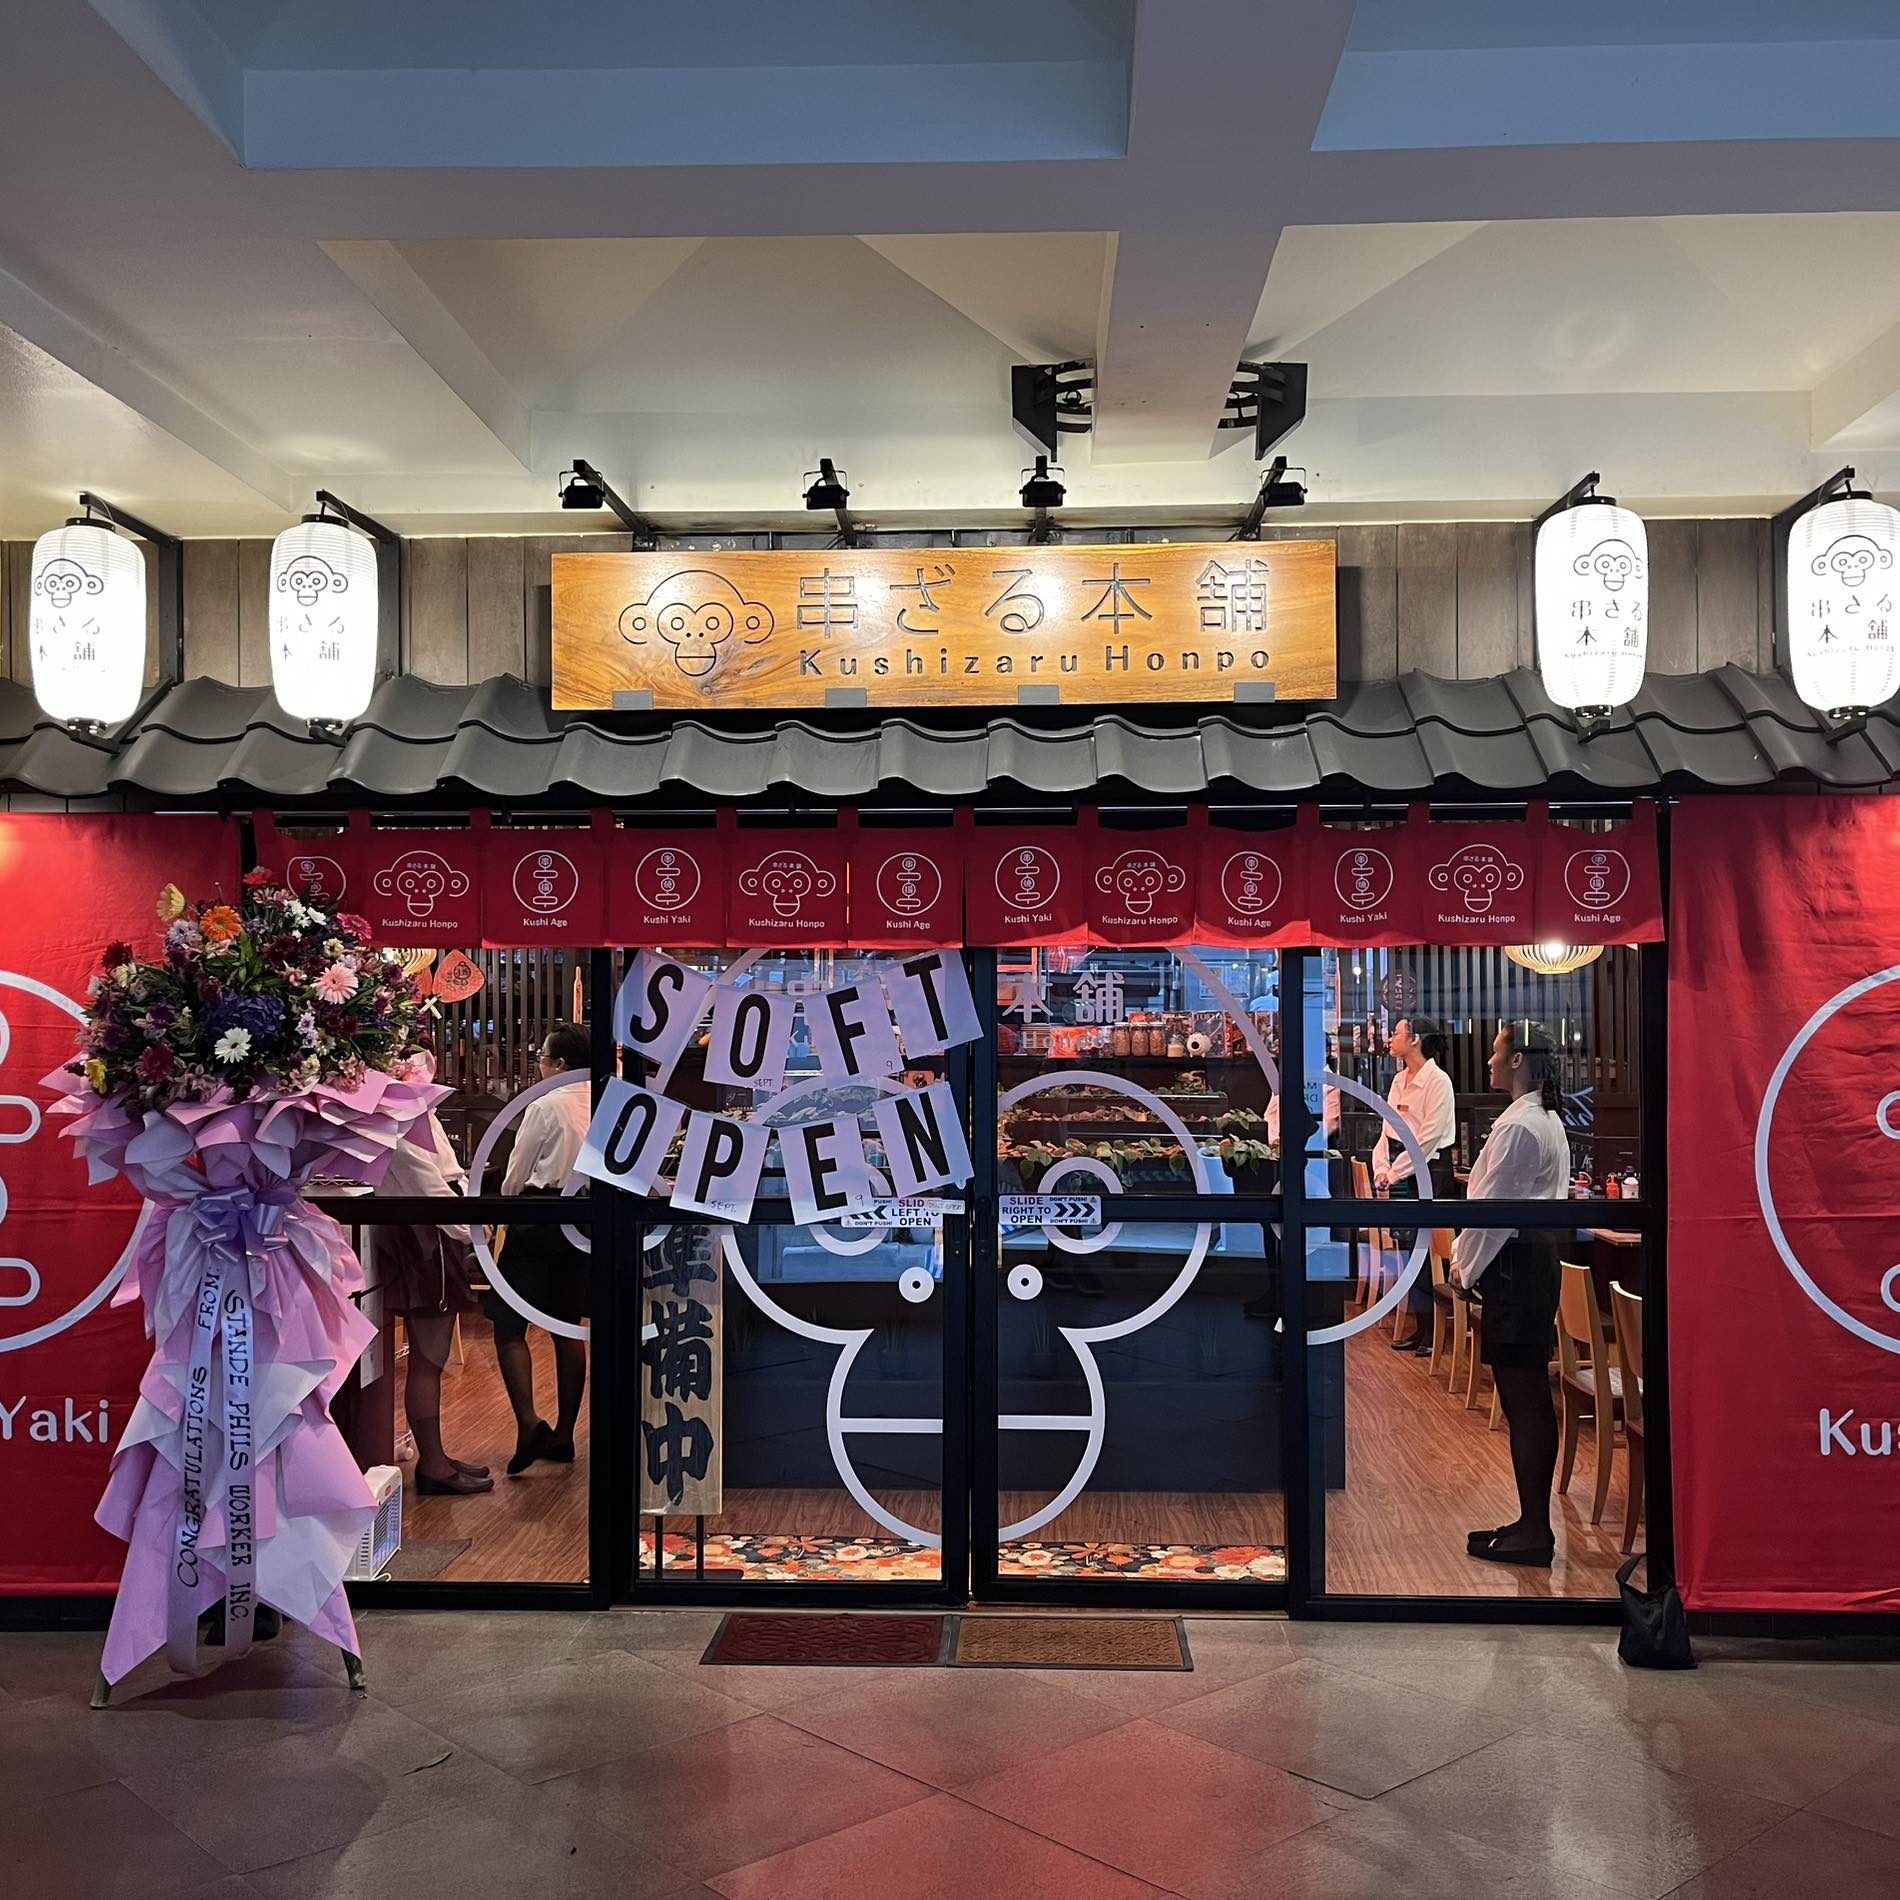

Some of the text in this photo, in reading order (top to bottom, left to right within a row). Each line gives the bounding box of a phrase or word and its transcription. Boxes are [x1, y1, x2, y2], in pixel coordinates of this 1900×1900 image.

[797, 559, 1269, 639] 串ざる本舗
[799, 645, 1269, 676] Kushizaru Honpo
[523, 918, 568, 928] Kushi Age
[643, 915, 691, 924] Kushi Yaki
[1004, 913, 1052, 924] Kushi Yaki
[1102, 915, 1178, 926] Kushizaru Honpo
[1227, 916, 1272, 928] Kushi Age
[1340, 912, 1388, 923] Kushi Yaki
[1438, 914, 1516, 924] Kushizaru Honpo
[1574, 914, 1621, 923] Kushi Age
[382, 918, 458, 929] Kushizaru Honpo
[749, 918, 825, 929] Kushizaru Honpo
[886, 920, 930, 930] Kushi Age
[1002, 972, 1125, 1023] 本舗
[630, 954, 948, 1077] SOFT
[604, 1092, 951, 1212] OPEN
[898, 1199, 925, 1208] SLID
[1010, 1197, 1044, 1205] SLIDE
[891, 1208, 919, 1217] LEFT
[899, 1217, 931, 1226] OPEN
[1011, 1215, 1043, 1224] OPEN
[0, 1396, 109, 1443] Yaki
[1819, 1408, 1900, 1456] Ku
[224, 1289, 252, 1622] STANDE PHILS WORKER INC.
[177, 1366, 207, 1588] CONGRATULATIONS
